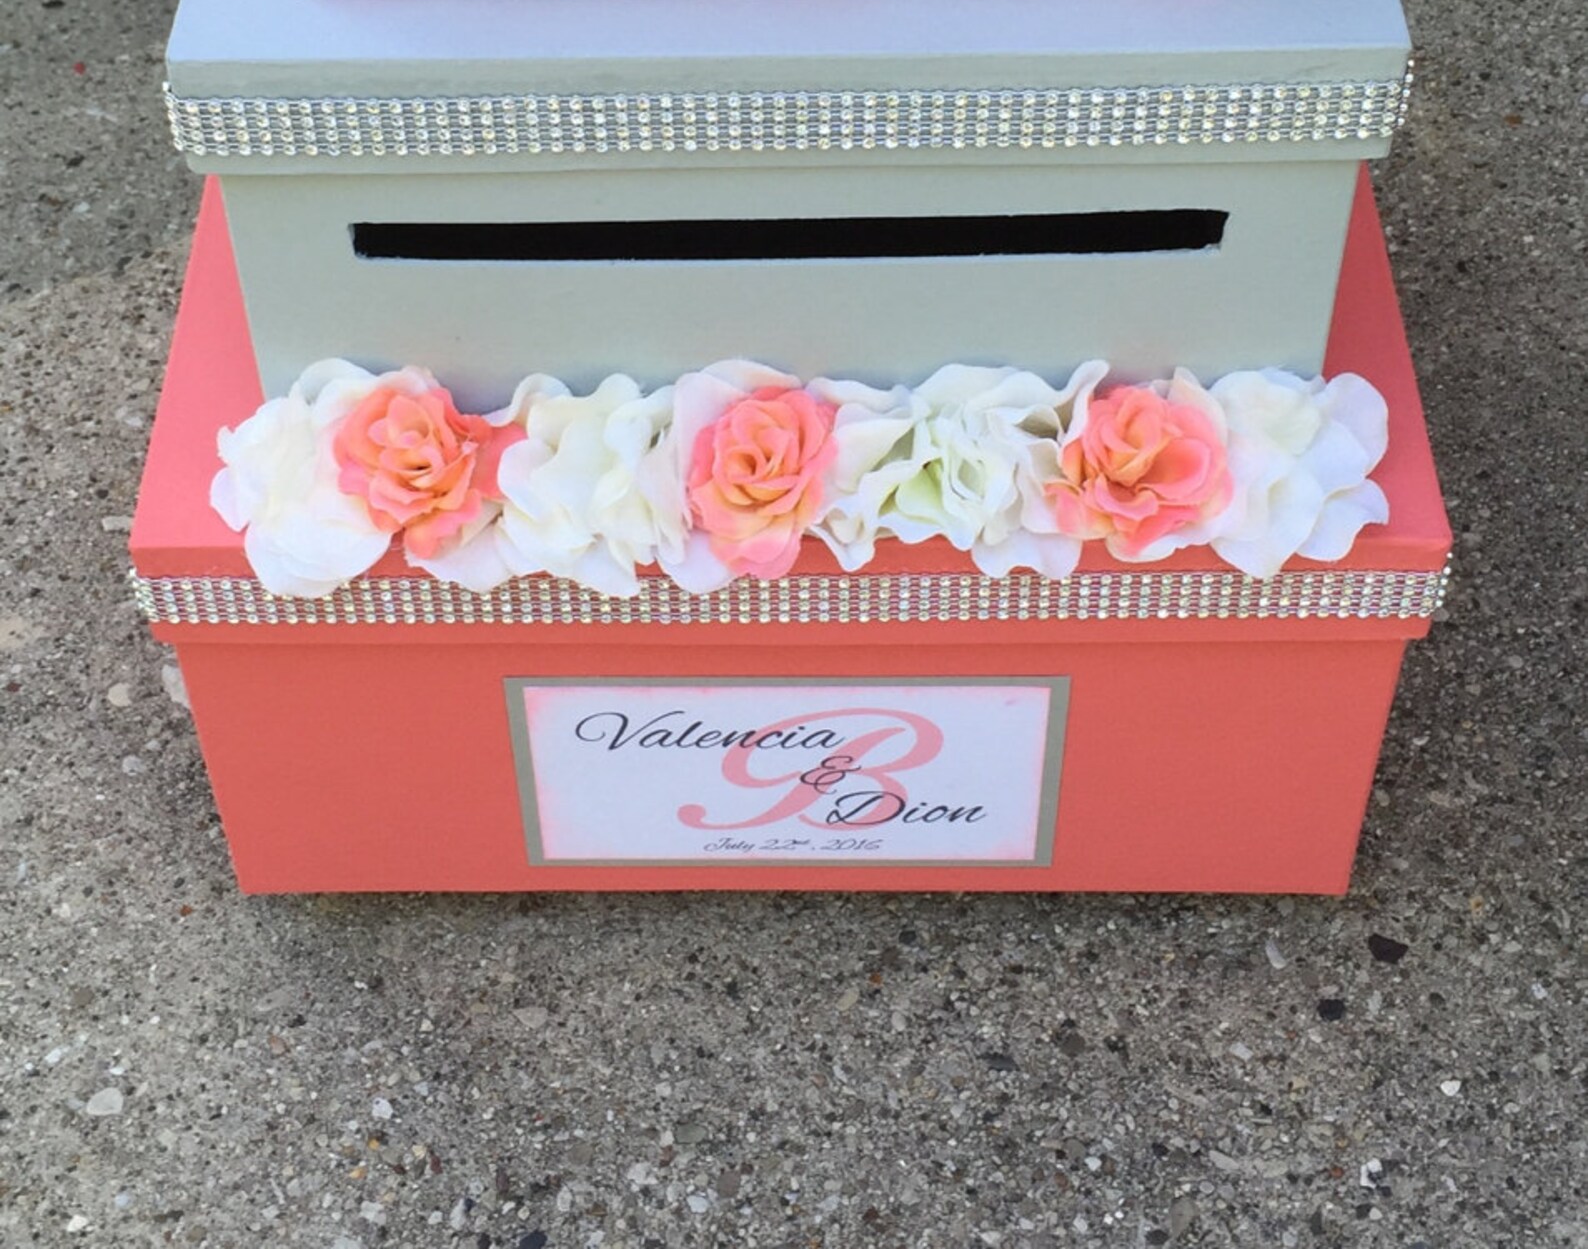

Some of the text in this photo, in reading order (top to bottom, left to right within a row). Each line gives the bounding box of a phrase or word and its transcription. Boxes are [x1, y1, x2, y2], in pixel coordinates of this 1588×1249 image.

[575, 711, 844, 751] Valencia
[677, 706, 944, 830] B
[800, 755, 862, 794] &
[825, 790, 987, 826] Dion
[703, 837, 756, 852] July
[820, 838, 884, 851] 2016
